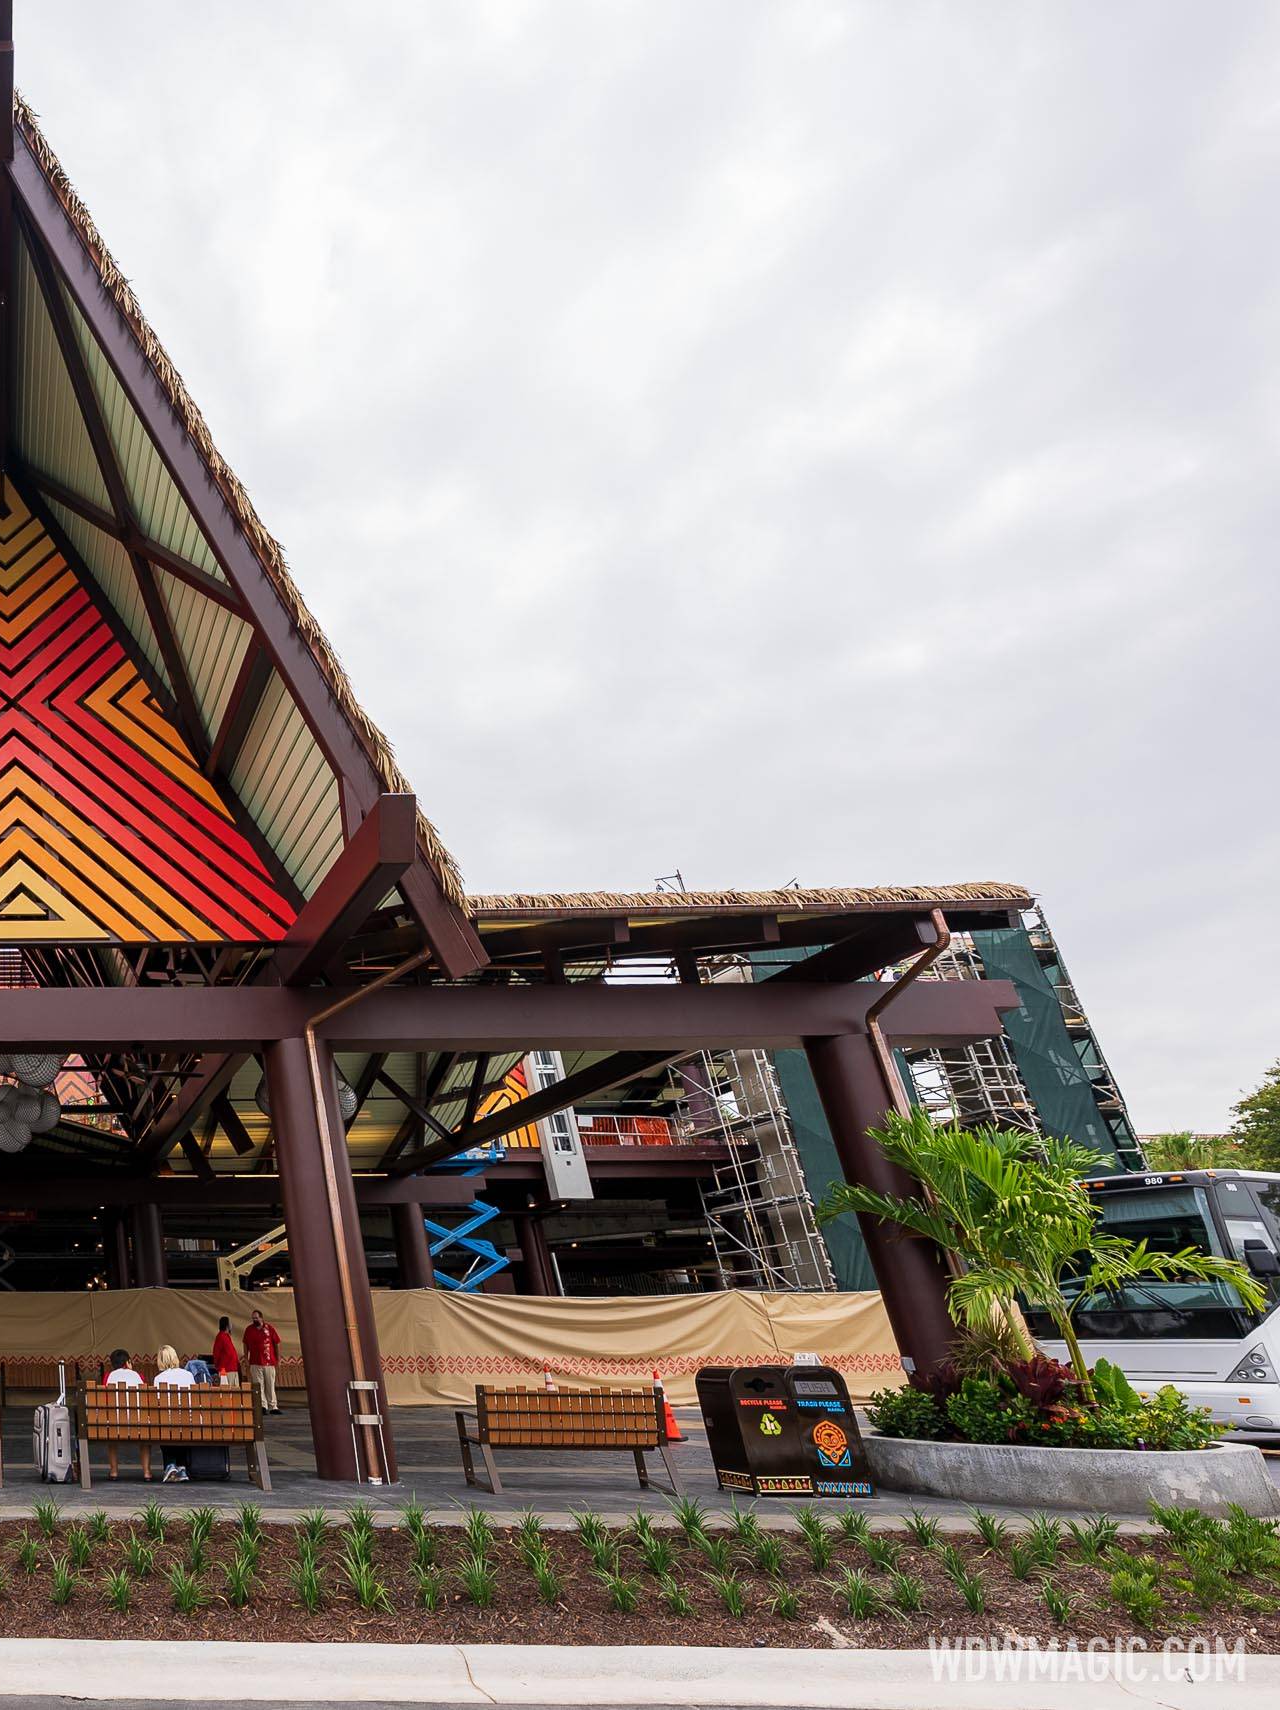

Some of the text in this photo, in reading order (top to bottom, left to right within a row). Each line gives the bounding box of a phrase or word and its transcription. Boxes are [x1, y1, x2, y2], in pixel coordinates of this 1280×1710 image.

[1144, 1176, 1163, 1185] 980
[799, 1382, 831, 1393] PUSH
[818, 1400, 841, 1408] PLEASE
